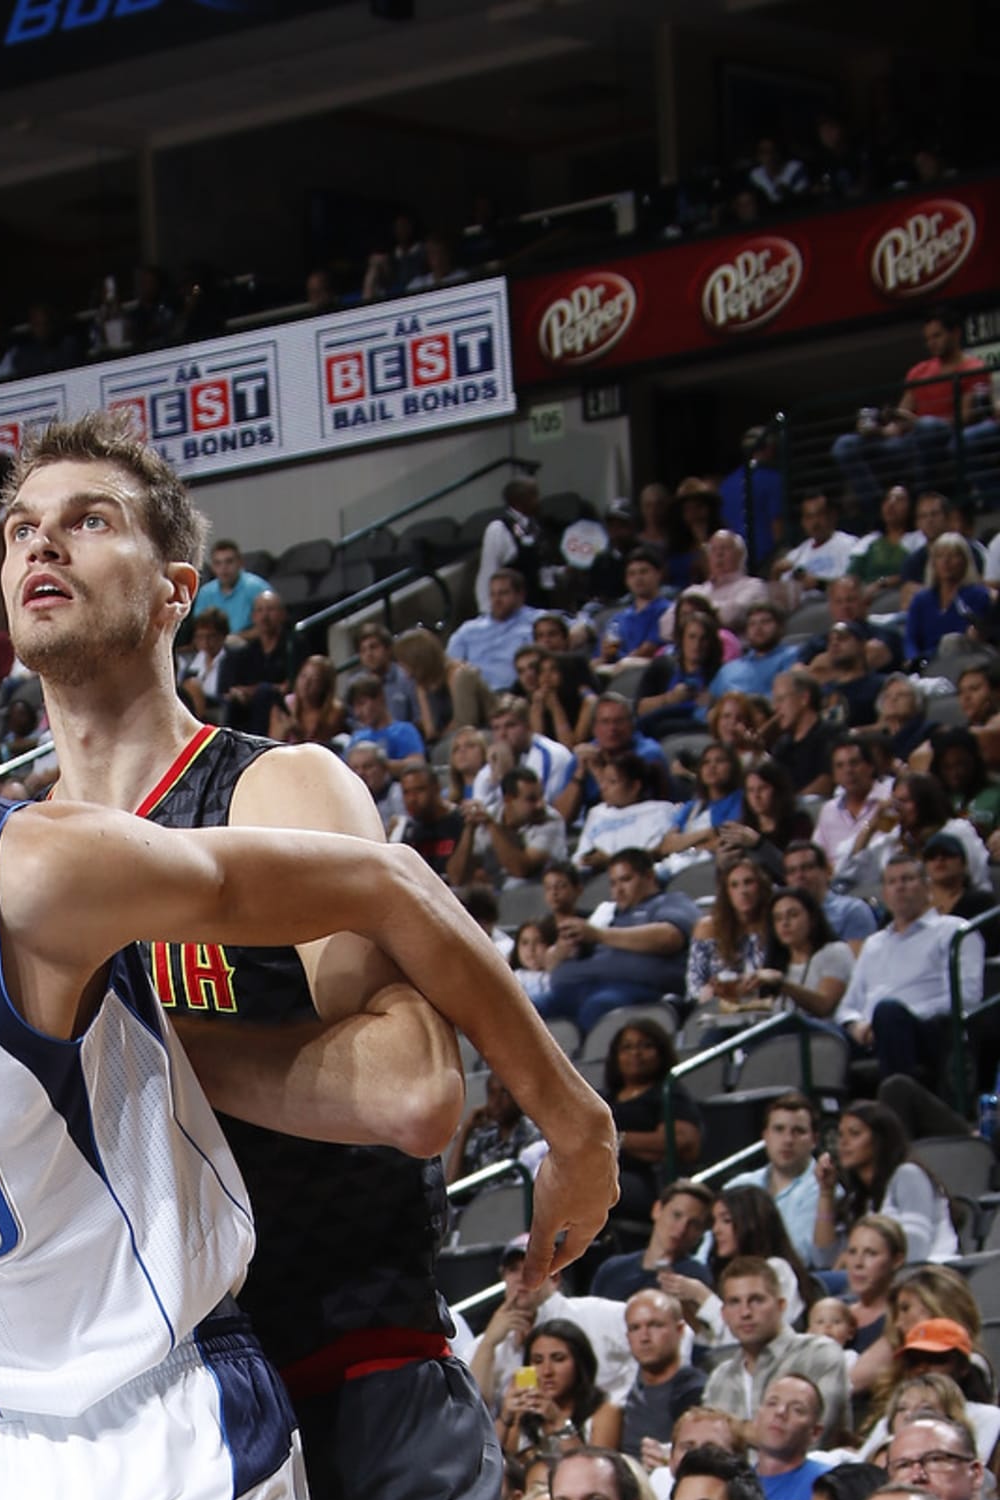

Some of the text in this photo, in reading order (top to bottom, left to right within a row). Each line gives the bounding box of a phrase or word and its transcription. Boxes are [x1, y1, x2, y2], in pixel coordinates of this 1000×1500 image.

[906, 212, 944, 250] Dr
[736, 249, 770, 286] Dr
[882, 219, 967, 291] Pepper
[571, 284, 606, 321] Dr
[709, 255, 795, 326] Pepper
[395, 315, 421, 336] AA
[546, 291, 627, 360] Pepper
[175, 361, 202, 383] AA
[326, 326, 493, 402] BEST
[333, 378, 497, 429] BAIL BONDS
[183, 423, 273, 459] BONDS
